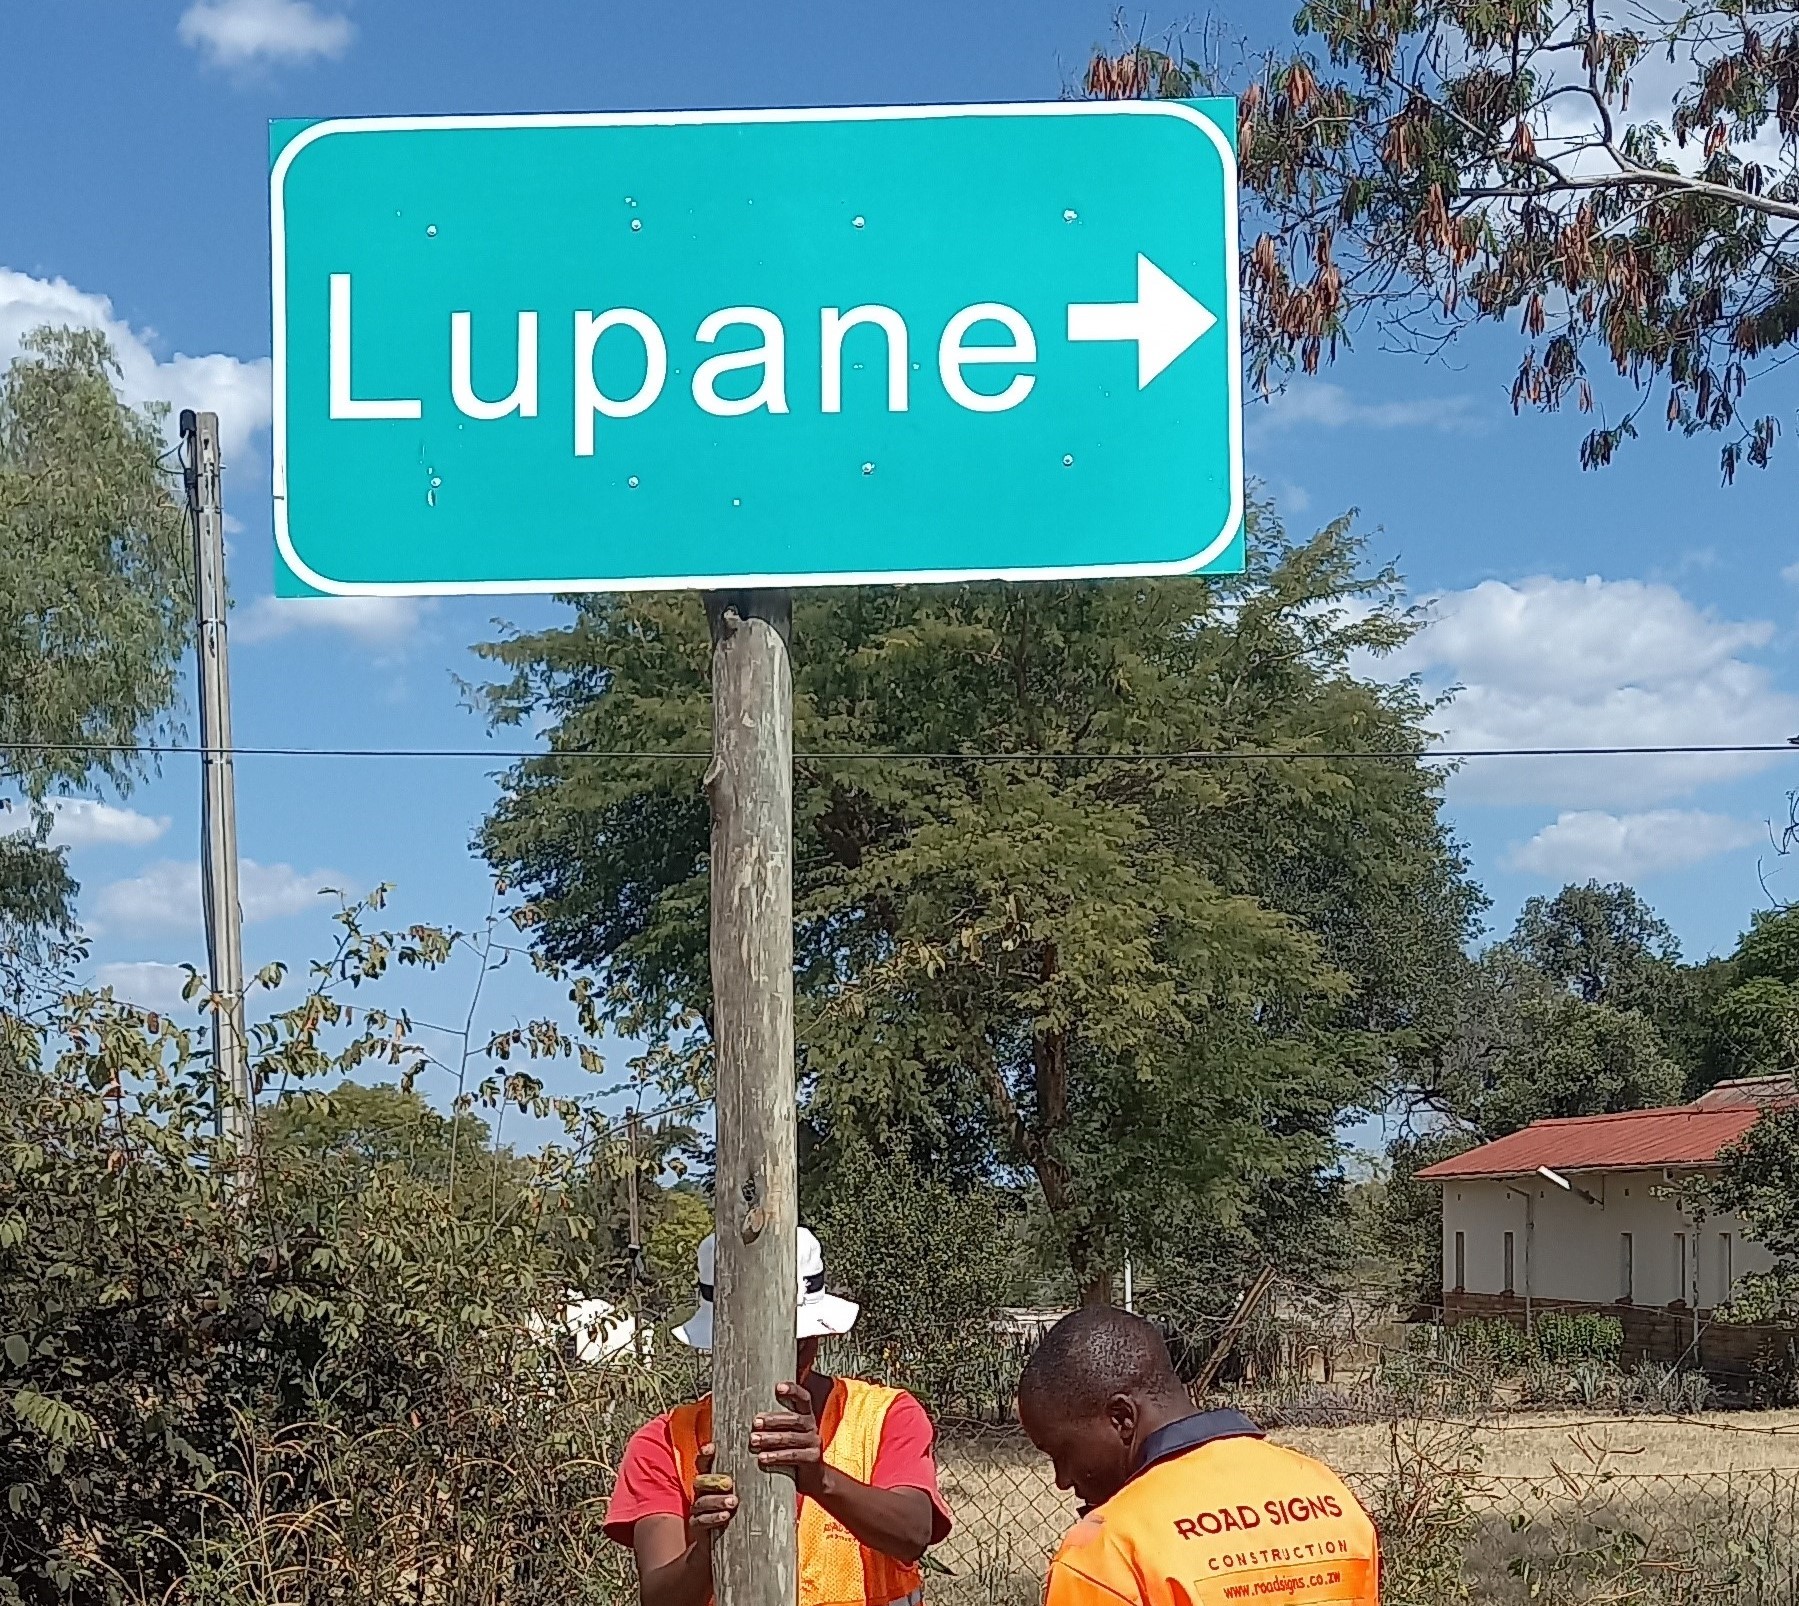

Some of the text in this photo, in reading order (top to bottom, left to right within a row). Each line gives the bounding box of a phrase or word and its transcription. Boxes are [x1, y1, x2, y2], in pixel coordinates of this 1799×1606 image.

[328, 272, 1038, 457] Lupane
[1174, 1495, 1342, 1540] ROAD SIGNS
[1209, 1540, 1347, 1570] CONSTRUCTION
[1224, 1572, 1340, 1599] www.roadsigns.co.zw
